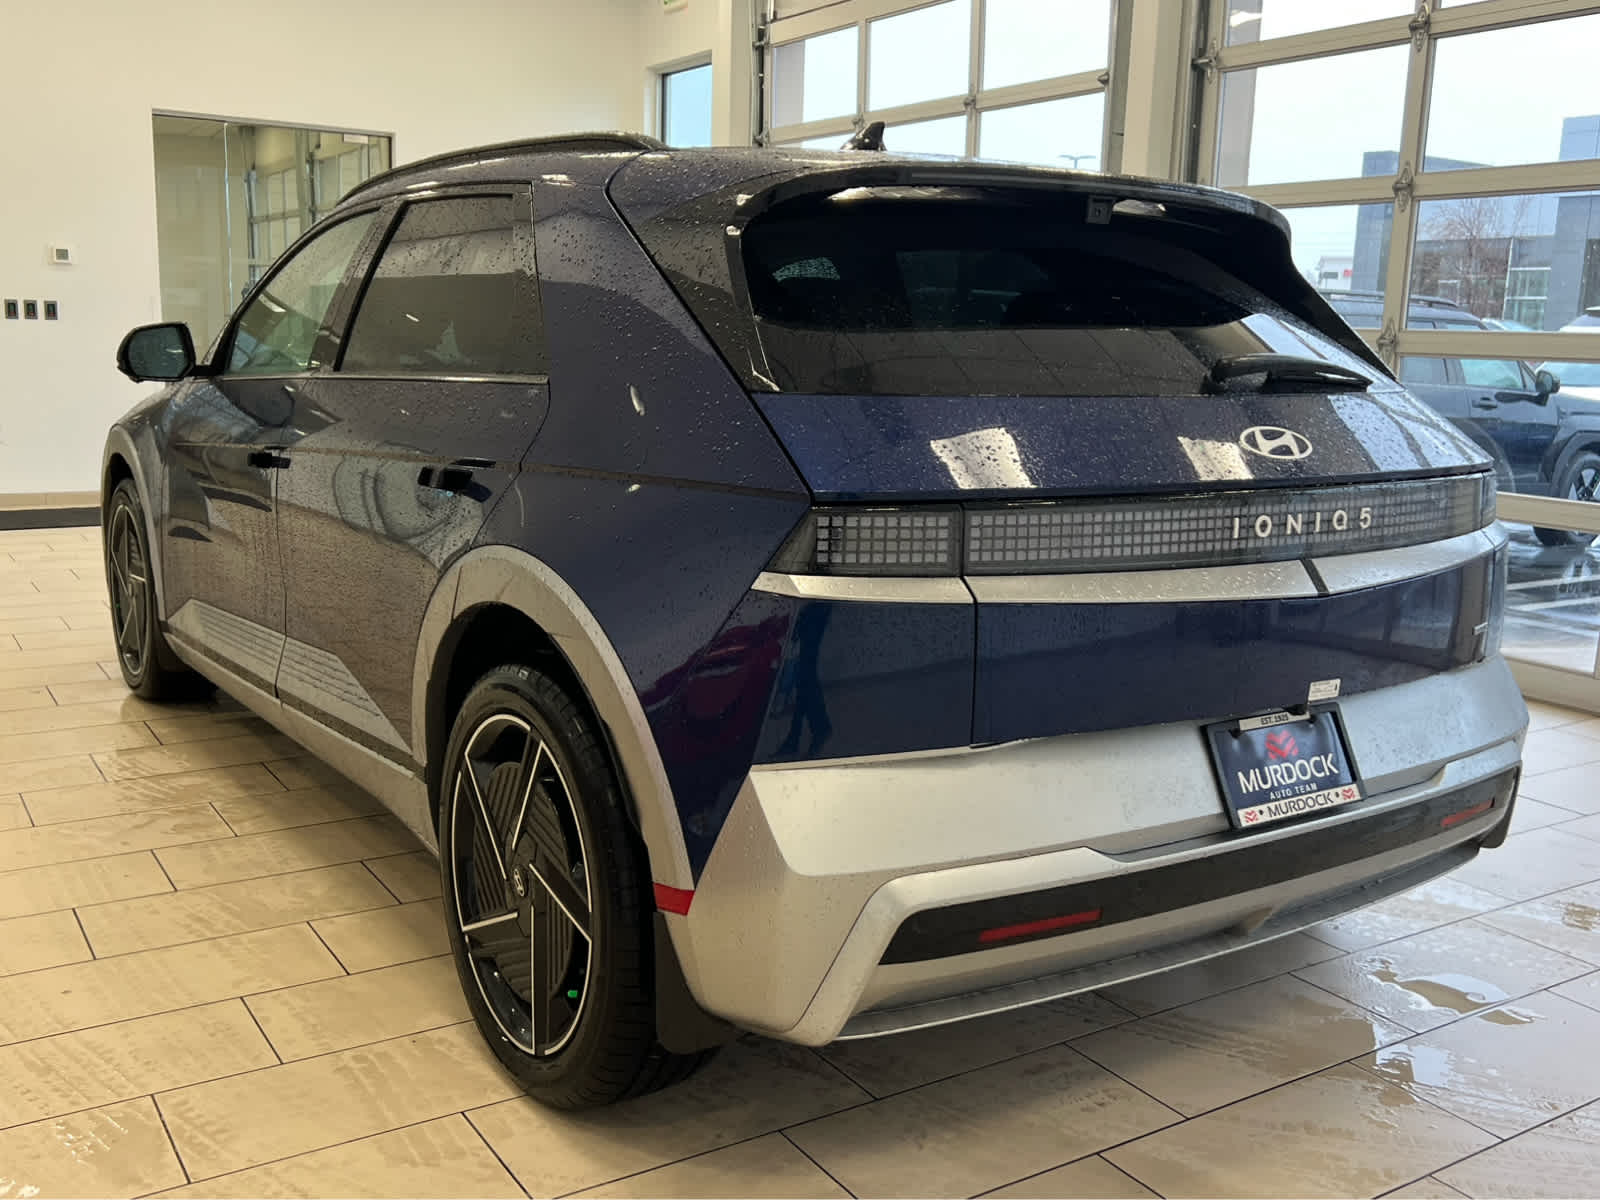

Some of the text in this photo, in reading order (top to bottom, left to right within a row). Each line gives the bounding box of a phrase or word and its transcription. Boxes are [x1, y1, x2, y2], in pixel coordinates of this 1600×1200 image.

[1237, 753, 1339, 794] MURDOCK
[1270, 783, 1318, 801] AUTO TEAM
[1267, 793, 1334, 817] MURDOCK
